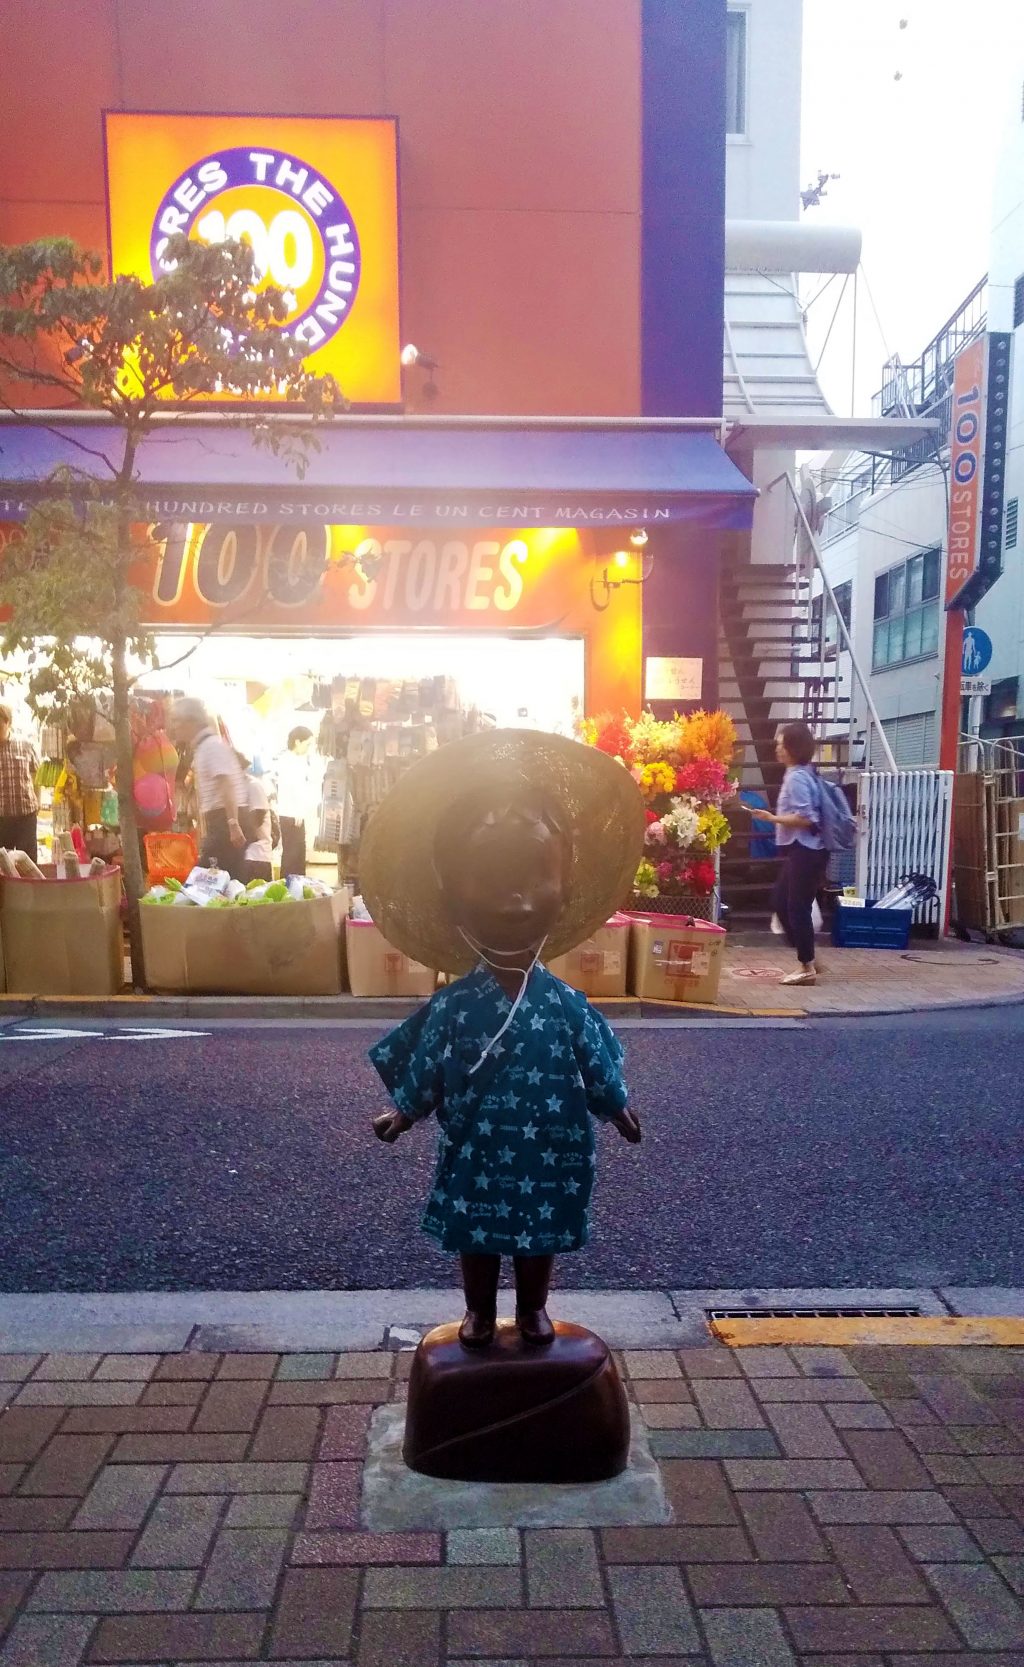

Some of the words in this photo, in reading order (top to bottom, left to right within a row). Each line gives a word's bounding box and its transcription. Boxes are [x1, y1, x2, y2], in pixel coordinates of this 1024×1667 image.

[249, 152, 335, 216] THE
[954, 383, 979, 484] 100
[146, 501, 268, 515] HUNDRED
[279, 503, 382, 516] STORES
[393, 504, 423, 516] LE
[435, 505, 468, 517] UN
[479, 506, 544, 518] CENT
[555, 507, 671, 520] MAGASIN
[949, 490, 972, 580] STORES
[348, 537, 529, 612] STORES
